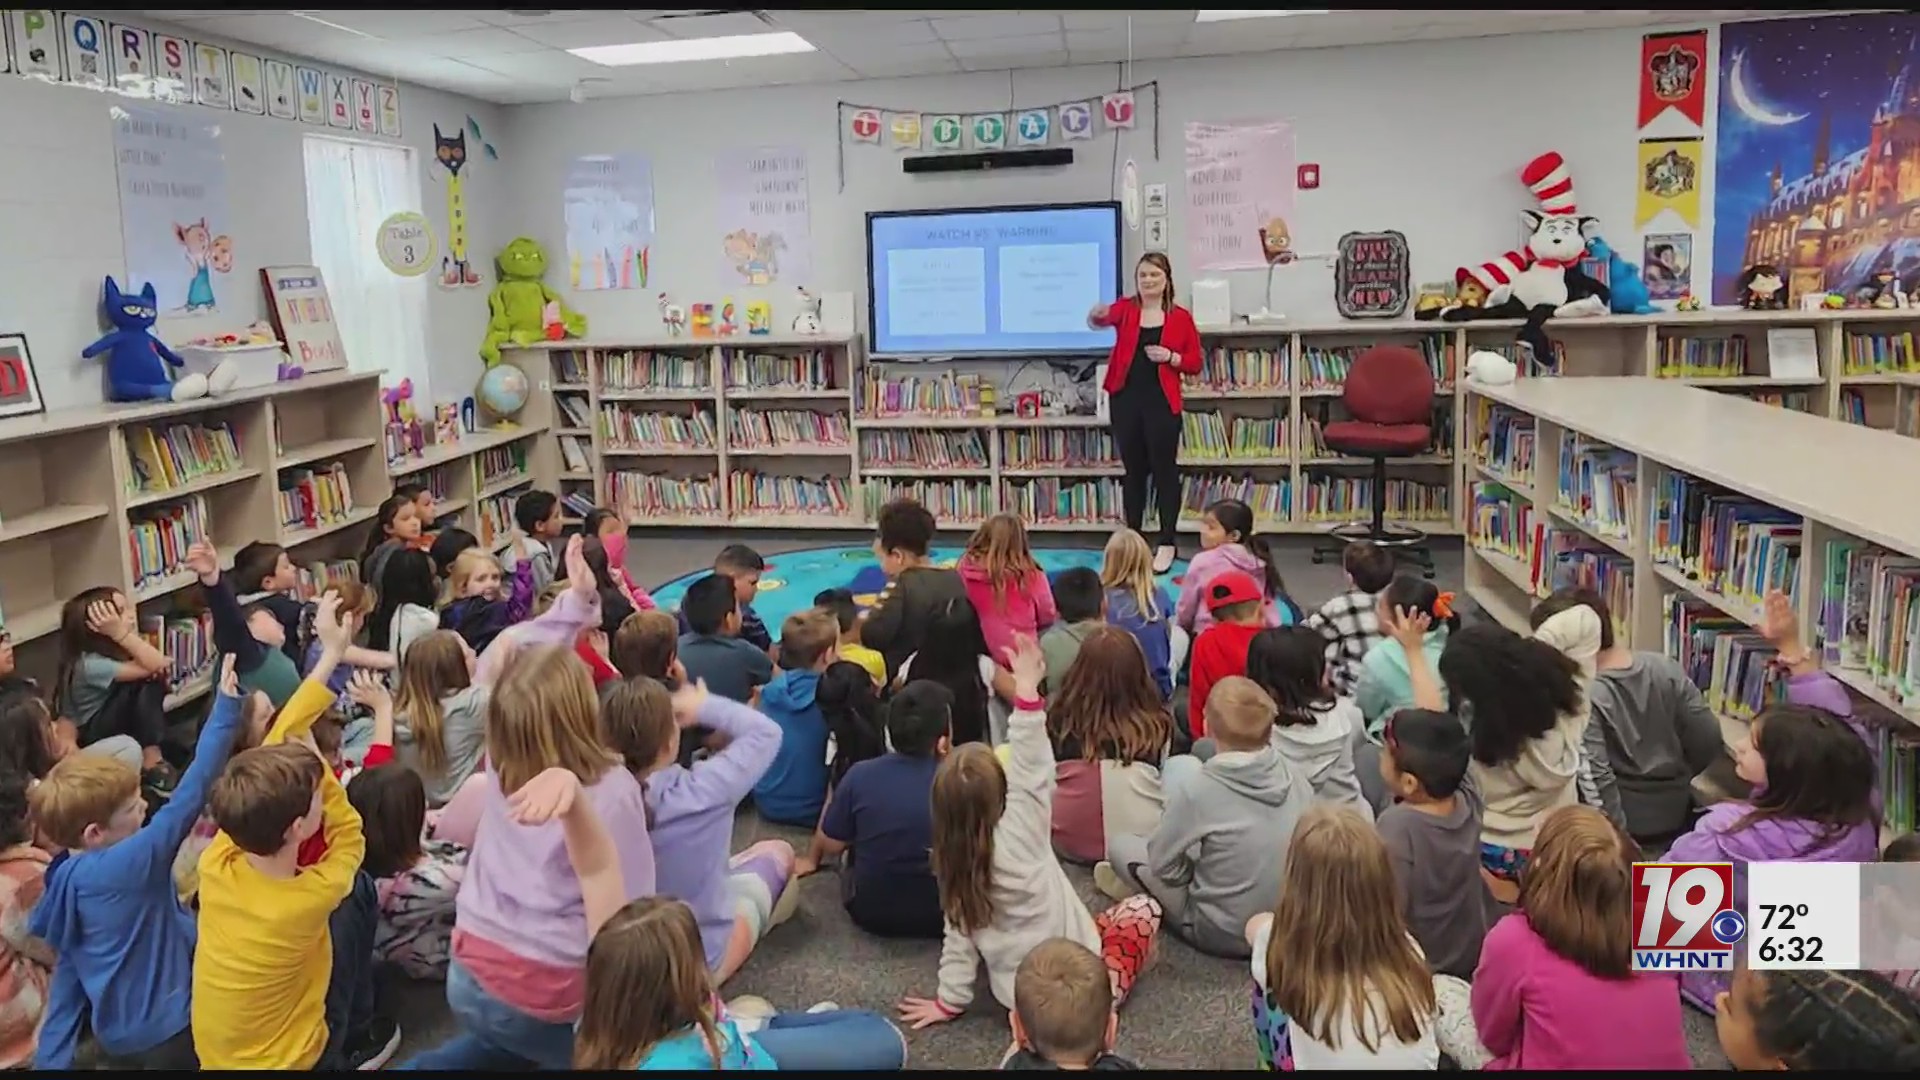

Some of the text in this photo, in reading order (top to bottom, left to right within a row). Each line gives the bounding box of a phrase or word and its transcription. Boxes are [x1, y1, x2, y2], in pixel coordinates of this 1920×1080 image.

[24, 11, 45, 39] P
[74, 19, 99, 53] Q
[121, 30, 141, 60] R
[165, 40, 182, 68] S
[203, 48, 219, 75] T
[272, 64, 287, 90] V
[300, 70, 319, 95] W
[332, 77, 345, 100] X
[359, 84, 370, 104] Y
[383, 90, 395, 111] Z
[389, 227, 423, 240] Table
[926, 227, 971, 240] WATCH
[403, 244, 415, 264] 3
[1347, 271, 1399, 282] LEARN
[1355, 290, 1391, 305] NEW
